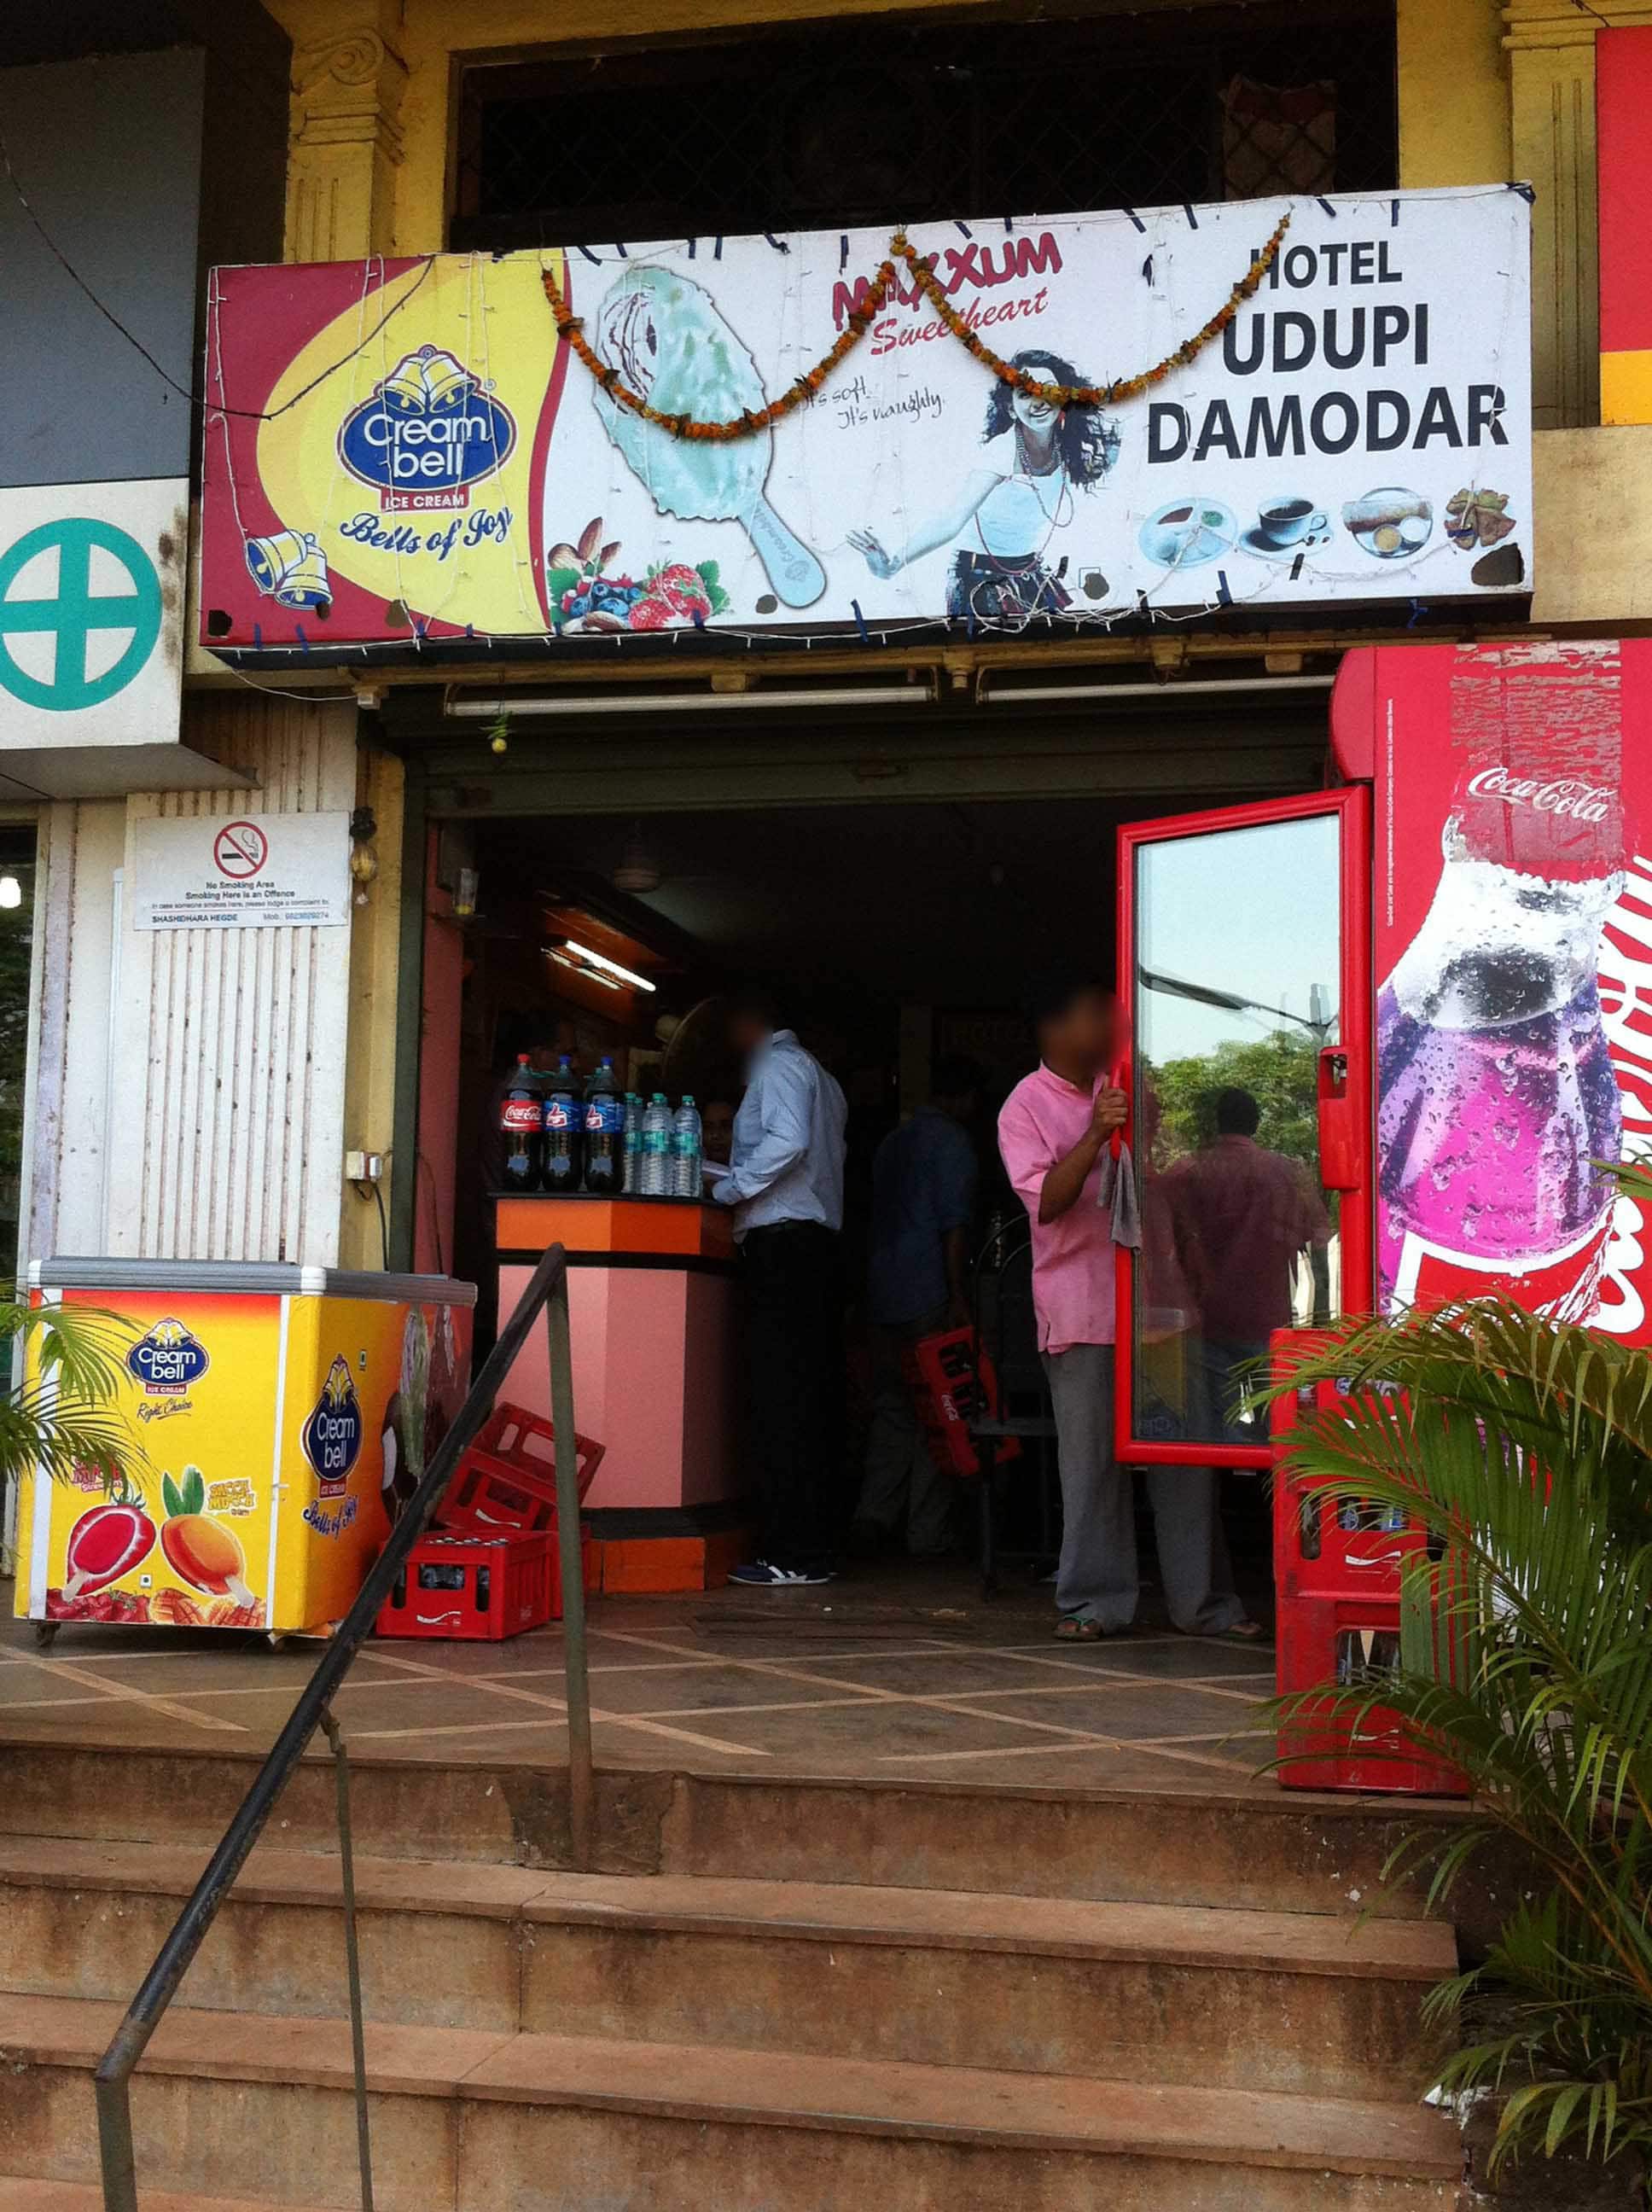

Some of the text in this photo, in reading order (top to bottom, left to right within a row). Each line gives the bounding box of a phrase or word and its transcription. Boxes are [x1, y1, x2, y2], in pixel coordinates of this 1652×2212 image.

[1250, 241, 1403, 290] HOTEL
[1223, 303, 1428, 375] UDUPI
[364, 414, 489, 446] Cream
[1148, 384, 1509, 463] DAMODAR
[393, 443, 462, 478] bell
[385, 494, 465, 509] ICE CREAM
[340, 505, 514, 562] Bells of Joy
[1468, 768, 1618, 823] Coca-Cola
[185, 891, 220, 900] Smoking
[223, 890, 241, 899] Here
[219, 881, 254, 890] Smoking
[138, 1348, 196, 1365] Cream
[151, 1364, 185, 1379] bell
[317, 1412, 355, 1441] Cream
[324, 1441, 347, 1469] bell
